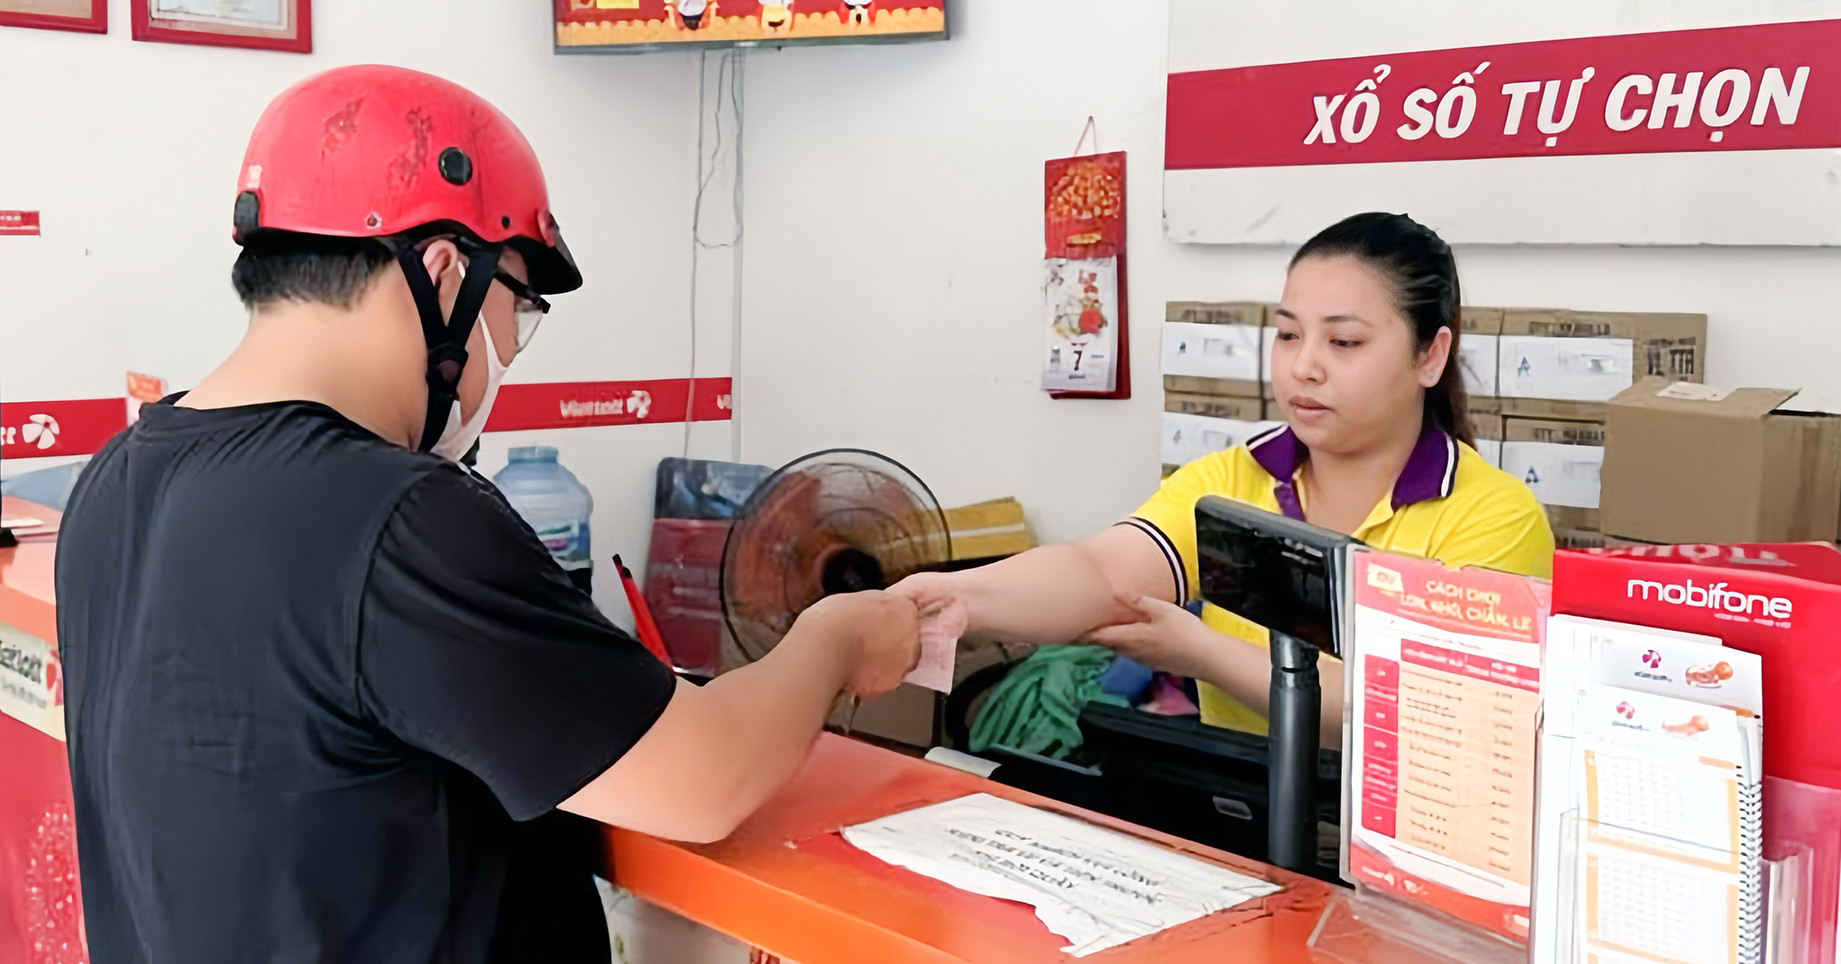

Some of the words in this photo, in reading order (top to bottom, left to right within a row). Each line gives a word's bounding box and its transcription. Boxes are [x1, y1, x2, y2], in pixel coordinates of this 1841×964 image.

[1303, 64, 1391, 146] XỔ
[1397, 61, 1491, 141] SỐ
[1501, 67, 1596, 147] TỰ
[1604, 66, 1810, 143] CHỌN
[1073, 350, 1083, 371] 7
[1627, 579, 1792, 619] mobifone
